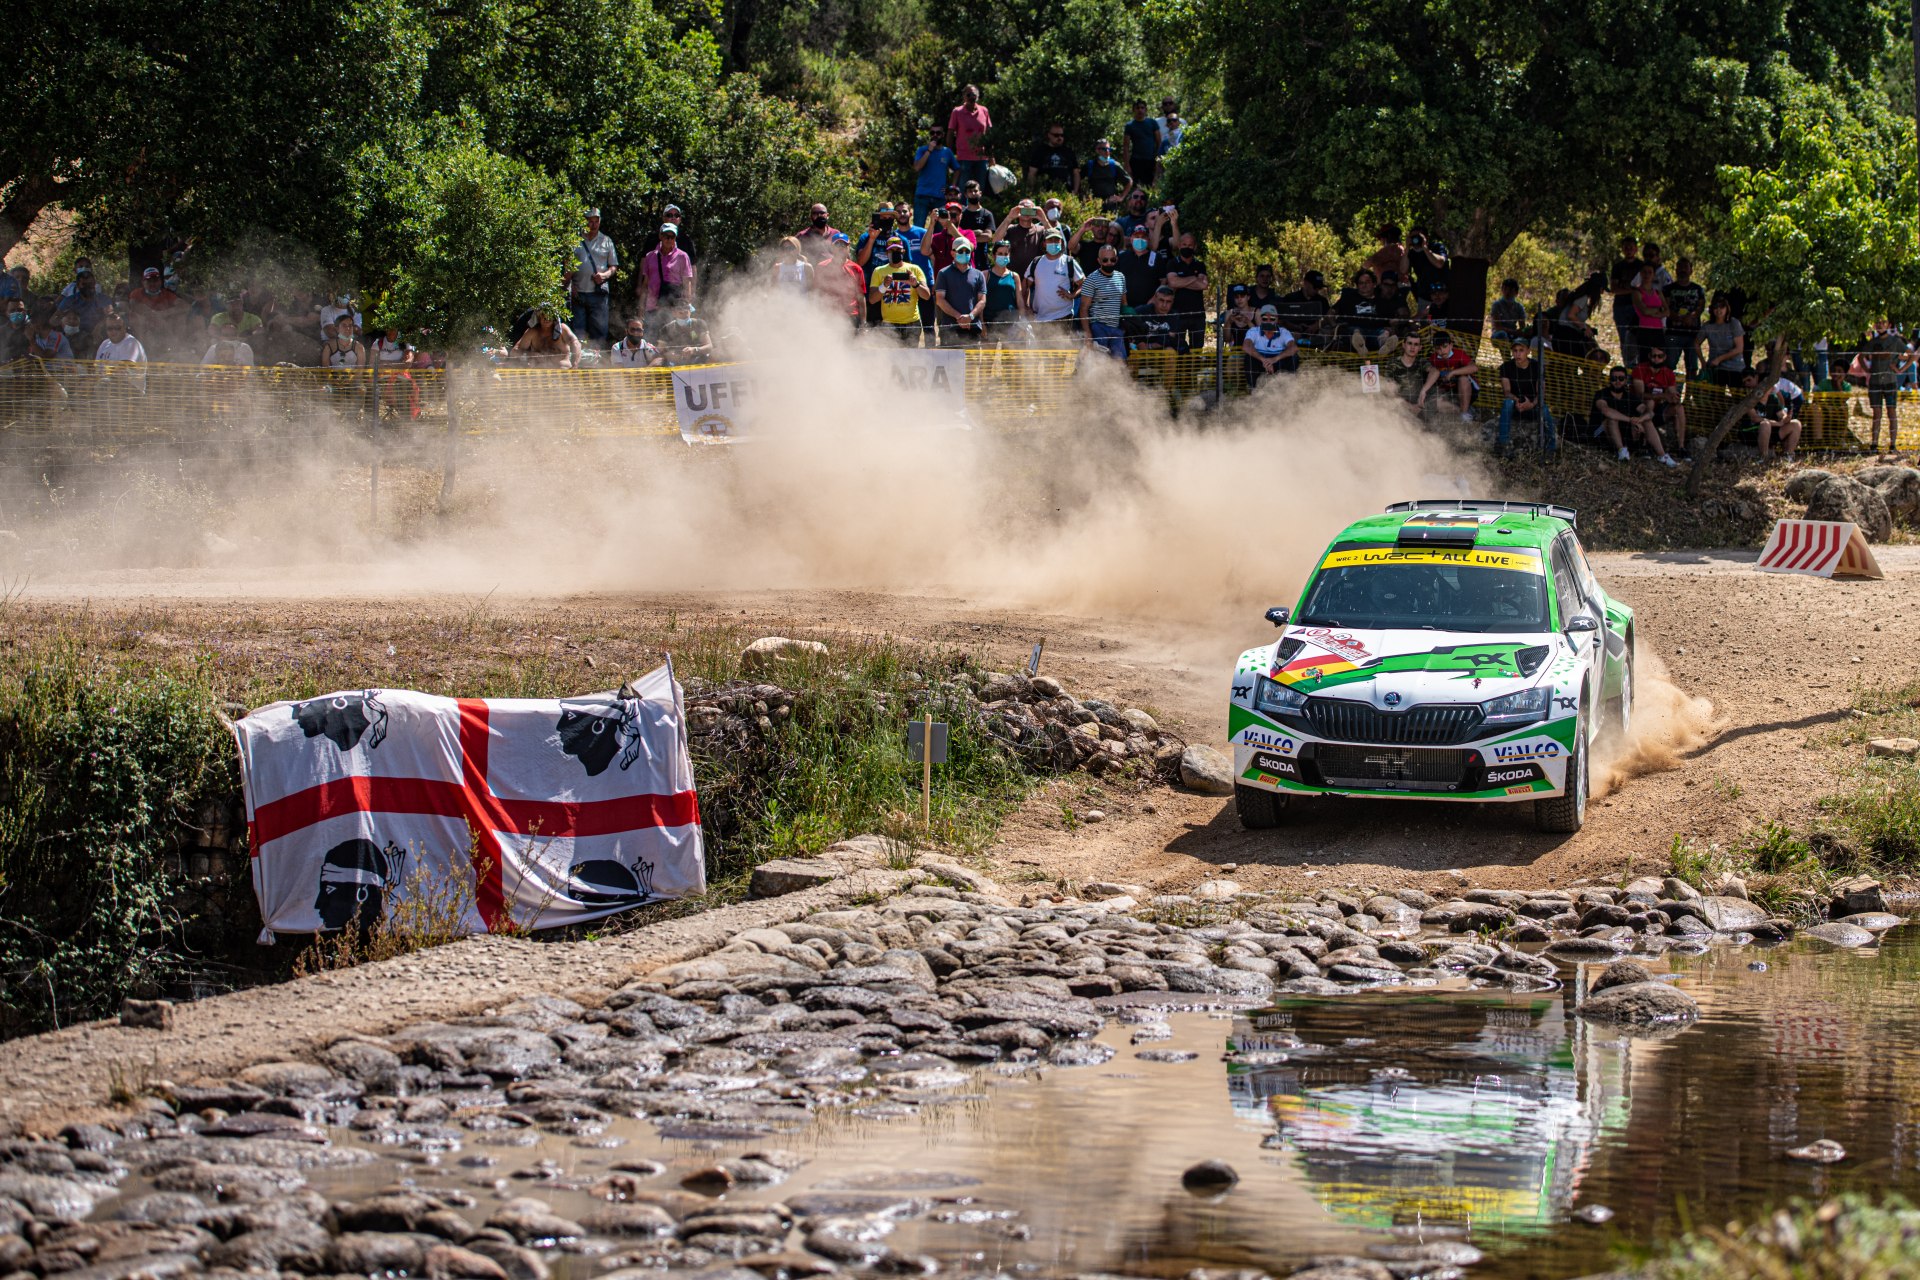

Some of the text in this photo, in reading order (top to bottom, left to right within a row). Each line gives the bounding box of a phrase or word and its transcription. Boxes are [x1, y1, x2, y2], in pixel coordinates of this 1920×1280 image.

[1442, 552, 1471, 562] ALL
[1475, 554, 1510, 566] LIVE
[1259, 755, 1295, 773] ŠKODA
[1487, 768, 1534, 783] ŠKODA
